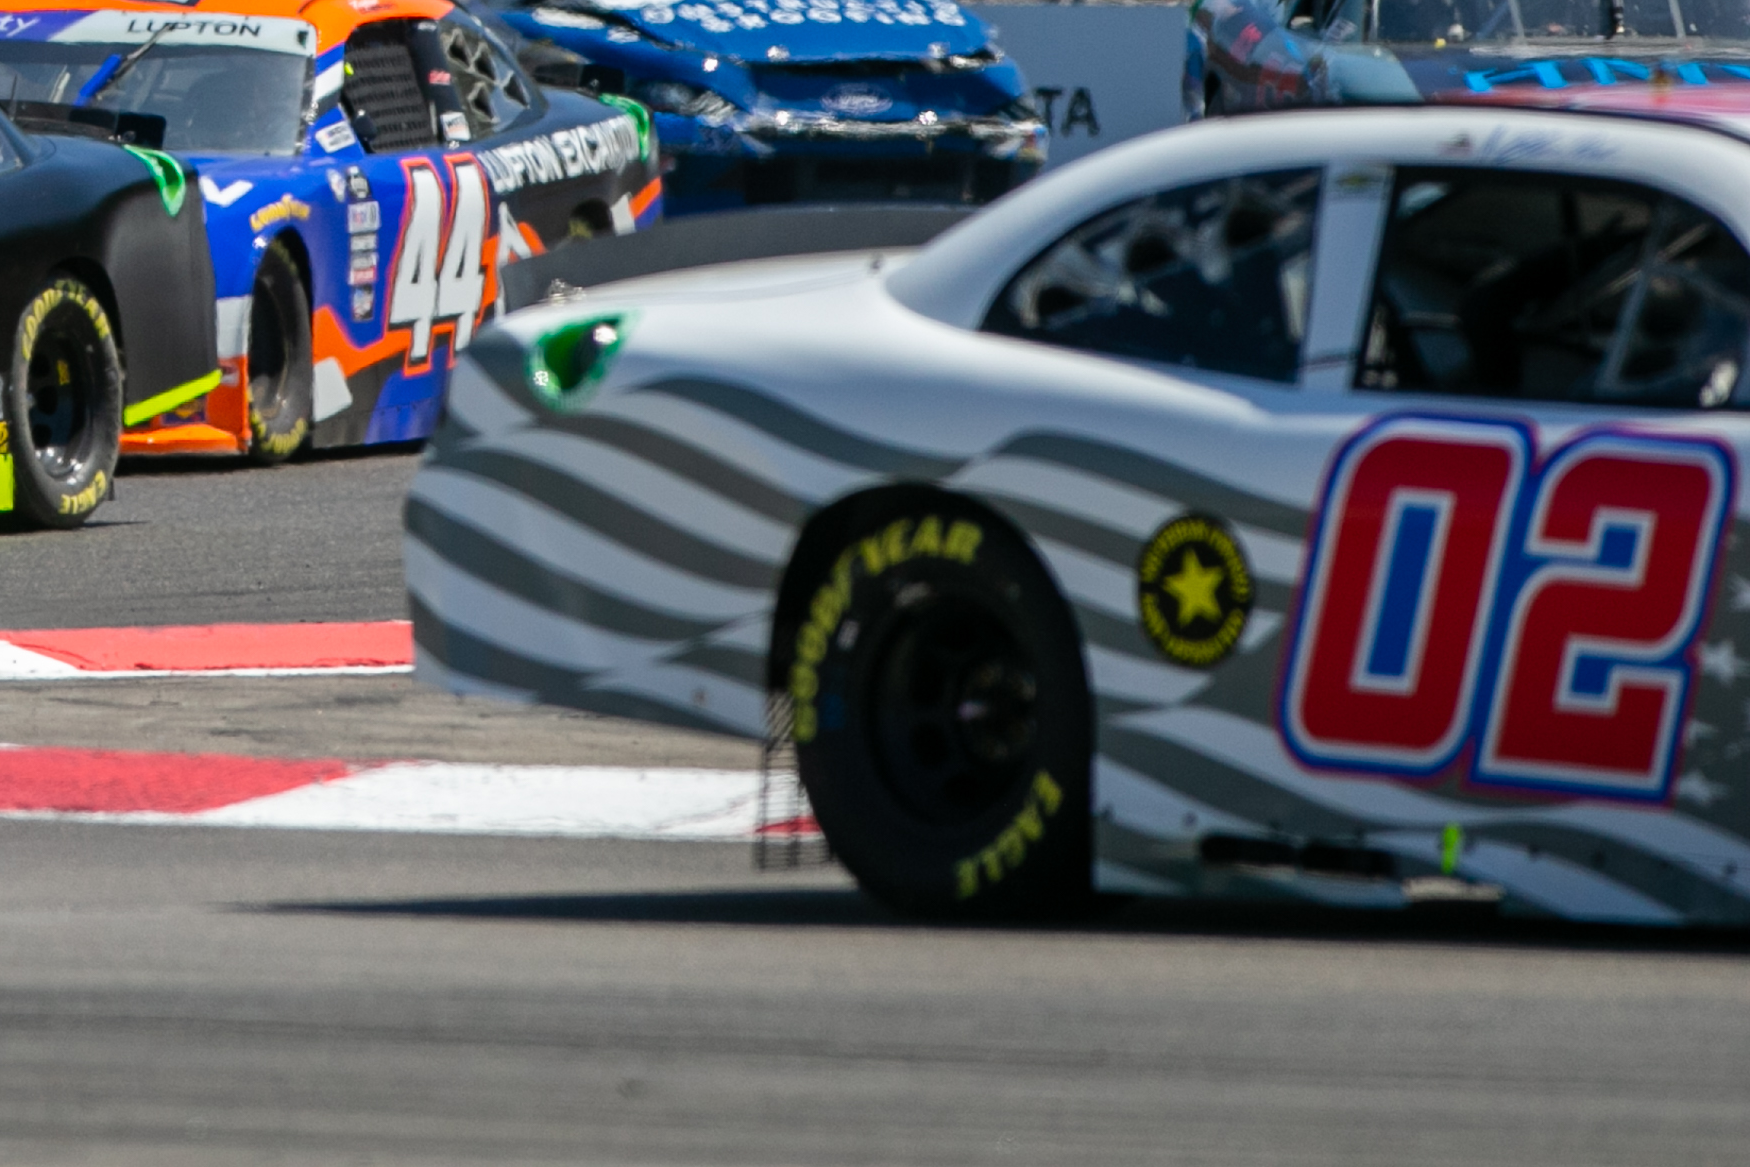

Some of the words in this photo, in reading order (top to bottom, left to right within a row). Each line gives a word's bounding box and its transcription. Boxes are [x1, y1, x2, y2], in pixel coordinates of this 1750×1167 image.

[127, 19, 262, 37] LUPTON
[477, 136, 564, 193] LUPTON
[387, 162, 488, 362] 44
[58, 470, 107, 515] EAGLE
[790, 516, 983, 743] GOODYEAR
[1285, 414, 1726, 796] 02
[956, 771, 1063, 900] EAGLE
